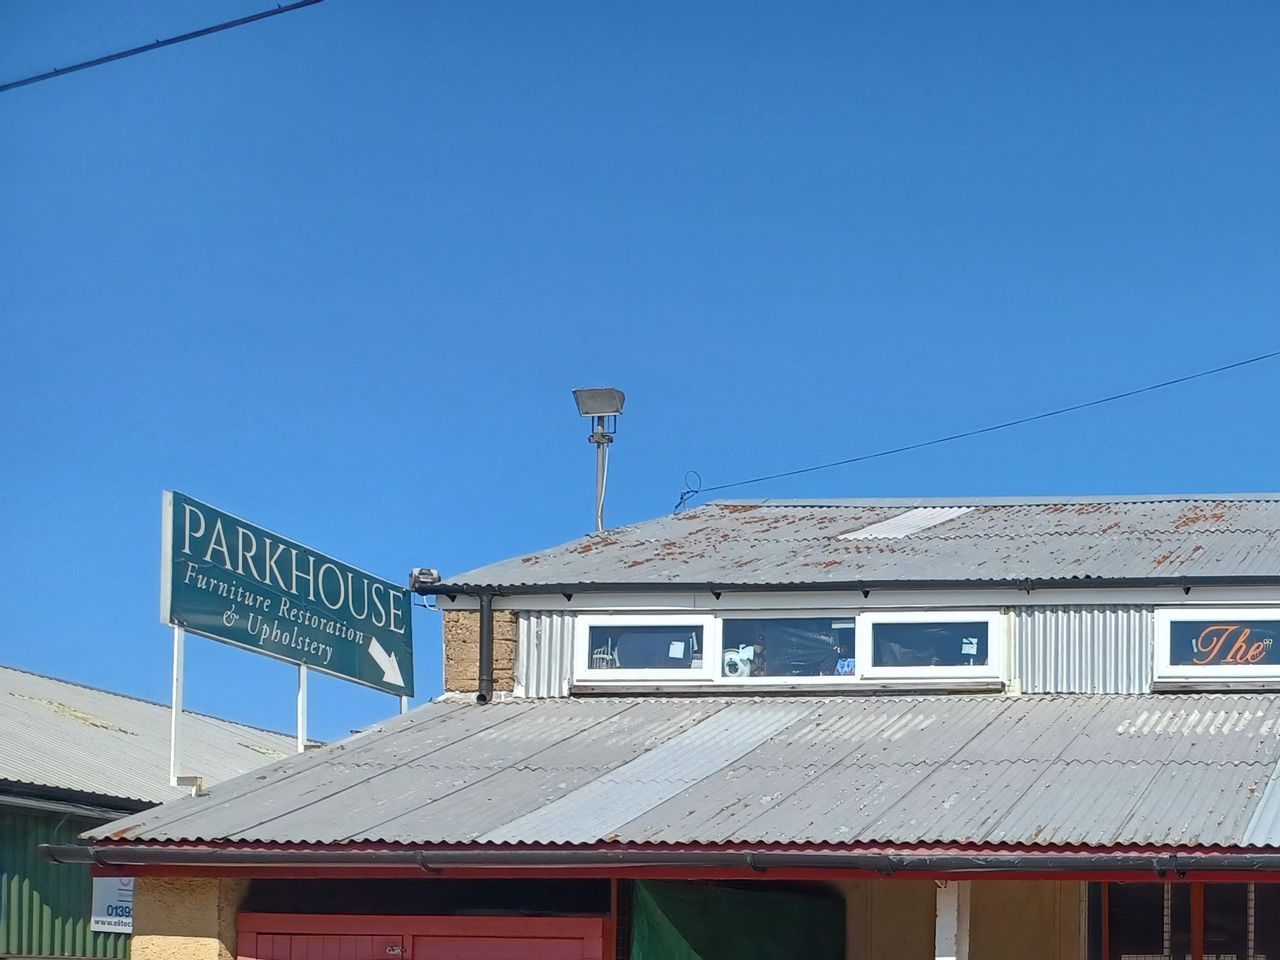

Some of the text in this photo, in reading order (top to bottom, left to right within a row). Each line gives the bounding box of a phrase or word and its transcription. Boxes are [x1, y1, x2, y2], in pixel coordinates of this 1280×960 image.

[182, 502, 406, 634] PARKHOUSE
[184, 562, 364, 645] Furniture Restoration
[223, 604, 333, 665] & Upholstery
[1192, 624, 1267, 665] The
[106, 904, 133, 918] 0139
